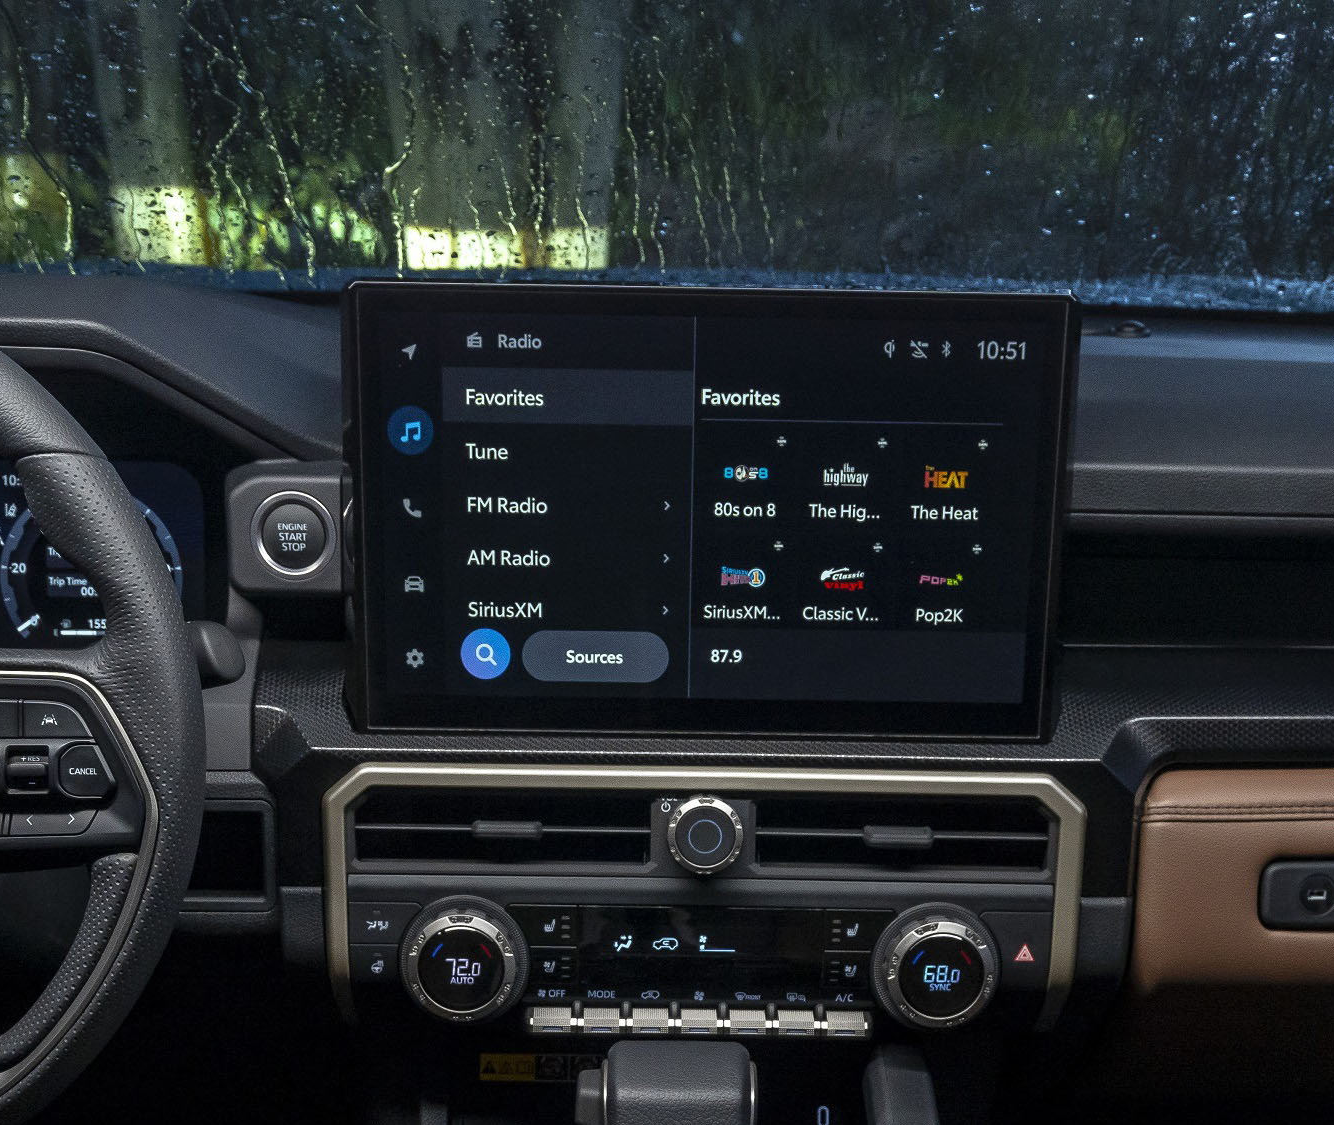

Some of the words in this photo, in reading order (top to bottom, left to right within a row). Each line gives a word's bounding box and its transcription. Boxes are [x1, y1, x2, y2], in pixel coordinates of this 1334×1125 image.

[498, 334, 542, 349] Radio
[977, 340, 1027, 360] 10:51
[466, 388, 544, 406] Favorites
[701, 389, 780, 406] Favorites
[466, 443, 508, 460] Tune
[2, 475, 20, 486] 10:
[823, 468, 868, 487] highway
[924, 471, 968, 489] HEAT
[467, 497, 492, 512] FM
[498, 498, 547, 514] Radio
[714, 502, 740, 517] 80s
[744, 506, 763, 517] on
[767, 504, 776, 517] 8
[809, 503, 837, 519] The
[840, 505, 880, 523] Hig...
[911, 505, 938, 521] The
[942, 506, 978, 521] Heat
[277, 523, 308, 531] ENGINE
[279, 532, 307, 541] START
[281, 542, 306, 551] STOP
[467, 550, 496, 566] AM
[501, 551, 550, 567] Radio
[11, 562, 26, 574] 20
[48, 576, 65, 587] Trip
[67, 576, 88, 586] Time
[832, 571, 865, 581] Classic
[81, 587, 97, 597] 00:
[468, 602, 542, 618] SiriusXM
[803, 607, 853, 621] Classic
[916, 608, 963, 625] Pop2K
[566, 650, 624, 664] Sources
[710, 650, 742, 663] 87.9
[69, 767, 97, 776] CANCEL
[445, 958, 482, 977] 72.0
[923, 965, 961, 984] 68.0
[450, 977, 474, 985] AUTO
[929, 983, 952, 992] SYNC
[548, 989, 566, 998] OFF
[587, 990, 616, 998] MODE
[835, 993, 854, 1003] A/C
